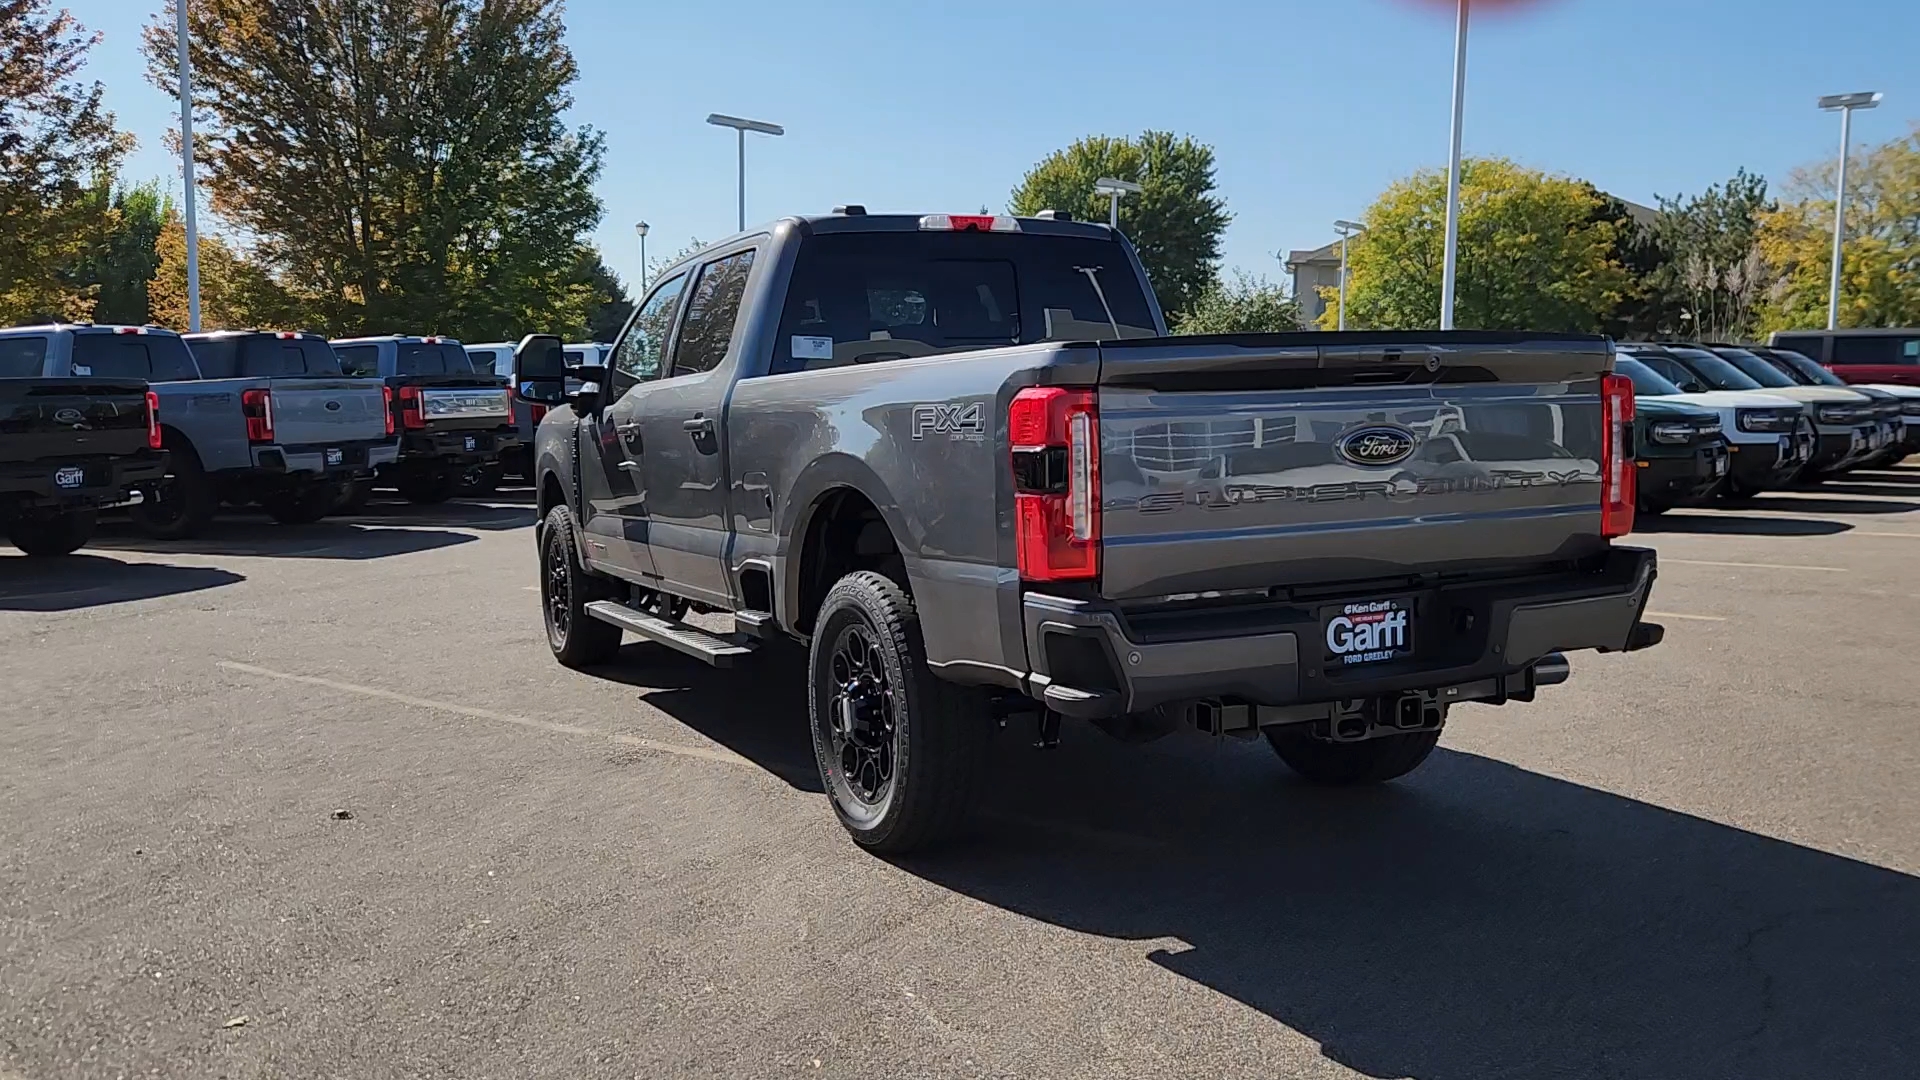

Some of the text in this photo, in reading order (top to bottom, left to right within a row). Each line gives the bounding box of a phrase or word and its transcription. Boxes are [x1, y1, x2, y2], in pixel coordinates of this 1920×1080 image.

[912, 402, 985, 440] FX4
[1360, 435, 1399, 457] Ford
[55, 469, 84, 485] Garff
[1352, 604, 1369, 614] Ken
[1326, 610, 1407, 654] Garff
[1344, 650, 1394, 664] FORD GREELEY
